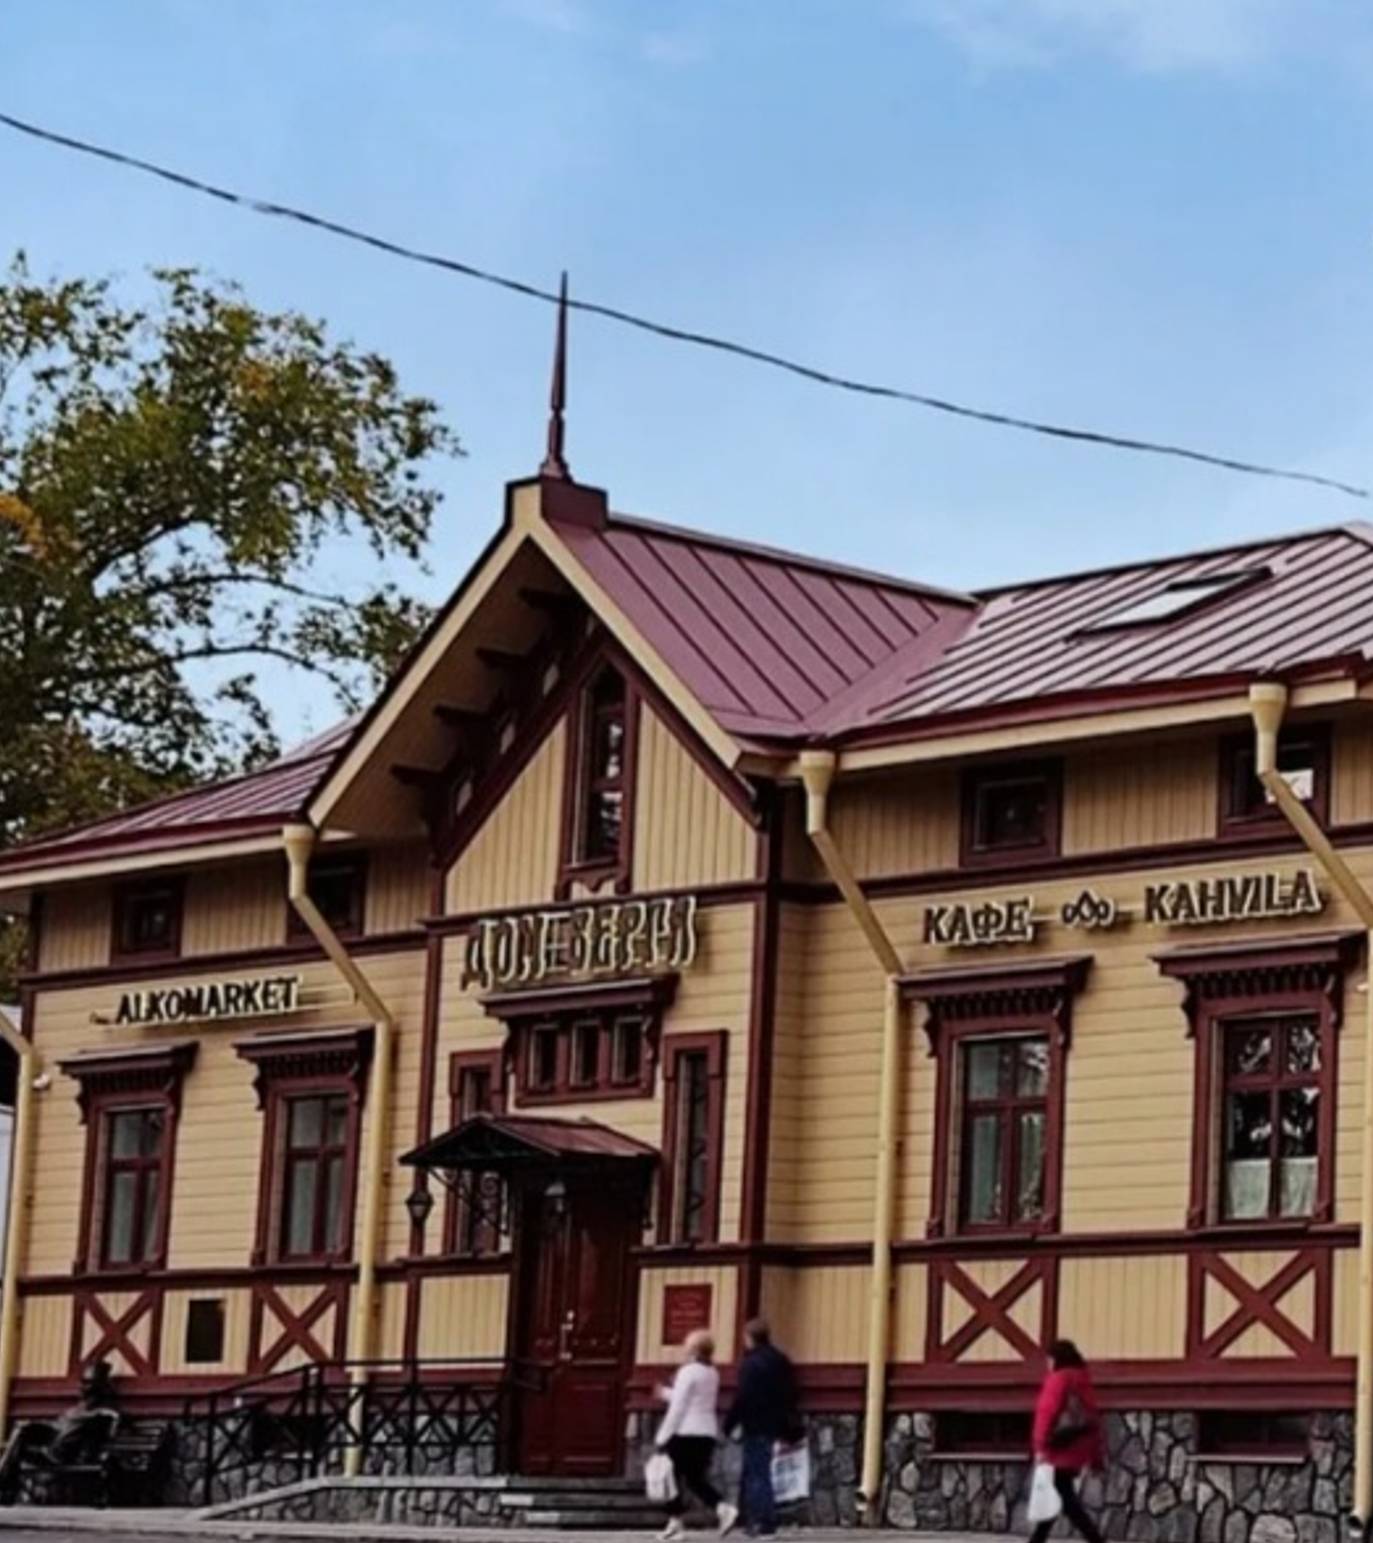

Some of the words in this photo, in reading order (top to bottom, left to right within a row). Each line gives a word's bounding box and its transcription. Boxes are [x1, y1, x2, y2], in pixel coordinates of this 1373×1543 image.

[923, 897, 1034, 945] КАФЕ
[1144, 869, 1322, 927] KAHVILA
[116, 974, 303, 1027] ALKOMARKET
